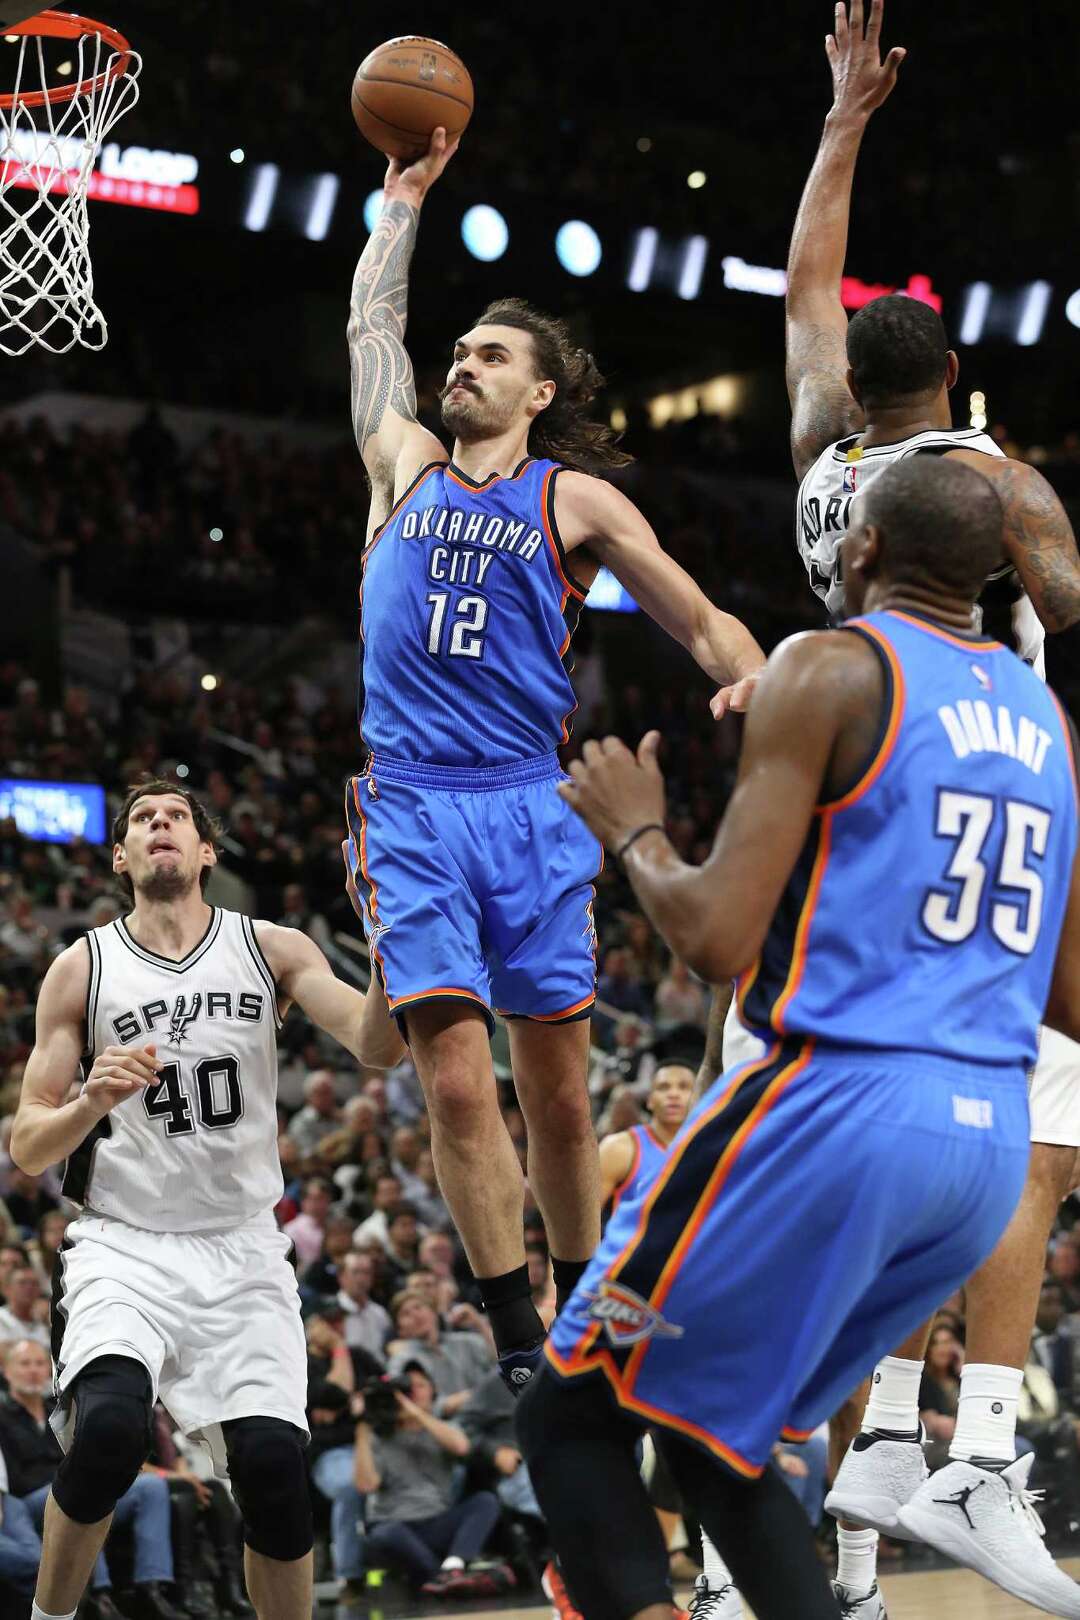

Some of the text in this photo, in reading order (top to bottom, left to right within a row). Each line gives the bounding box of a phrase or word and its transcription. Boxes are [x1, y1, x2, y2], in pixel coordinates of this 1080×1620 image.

[401, 505, 543, 563] OKLAHOMA
[429, 547, 494, 585] CITY
[427, 591, 489, 661] 12
[938, 699, 1052, 775] DURANT
[920, 787, 1052, 956] 35
[112, 991, 265, 1045] SPURS
[142, 1053, 244, 1138] 40
